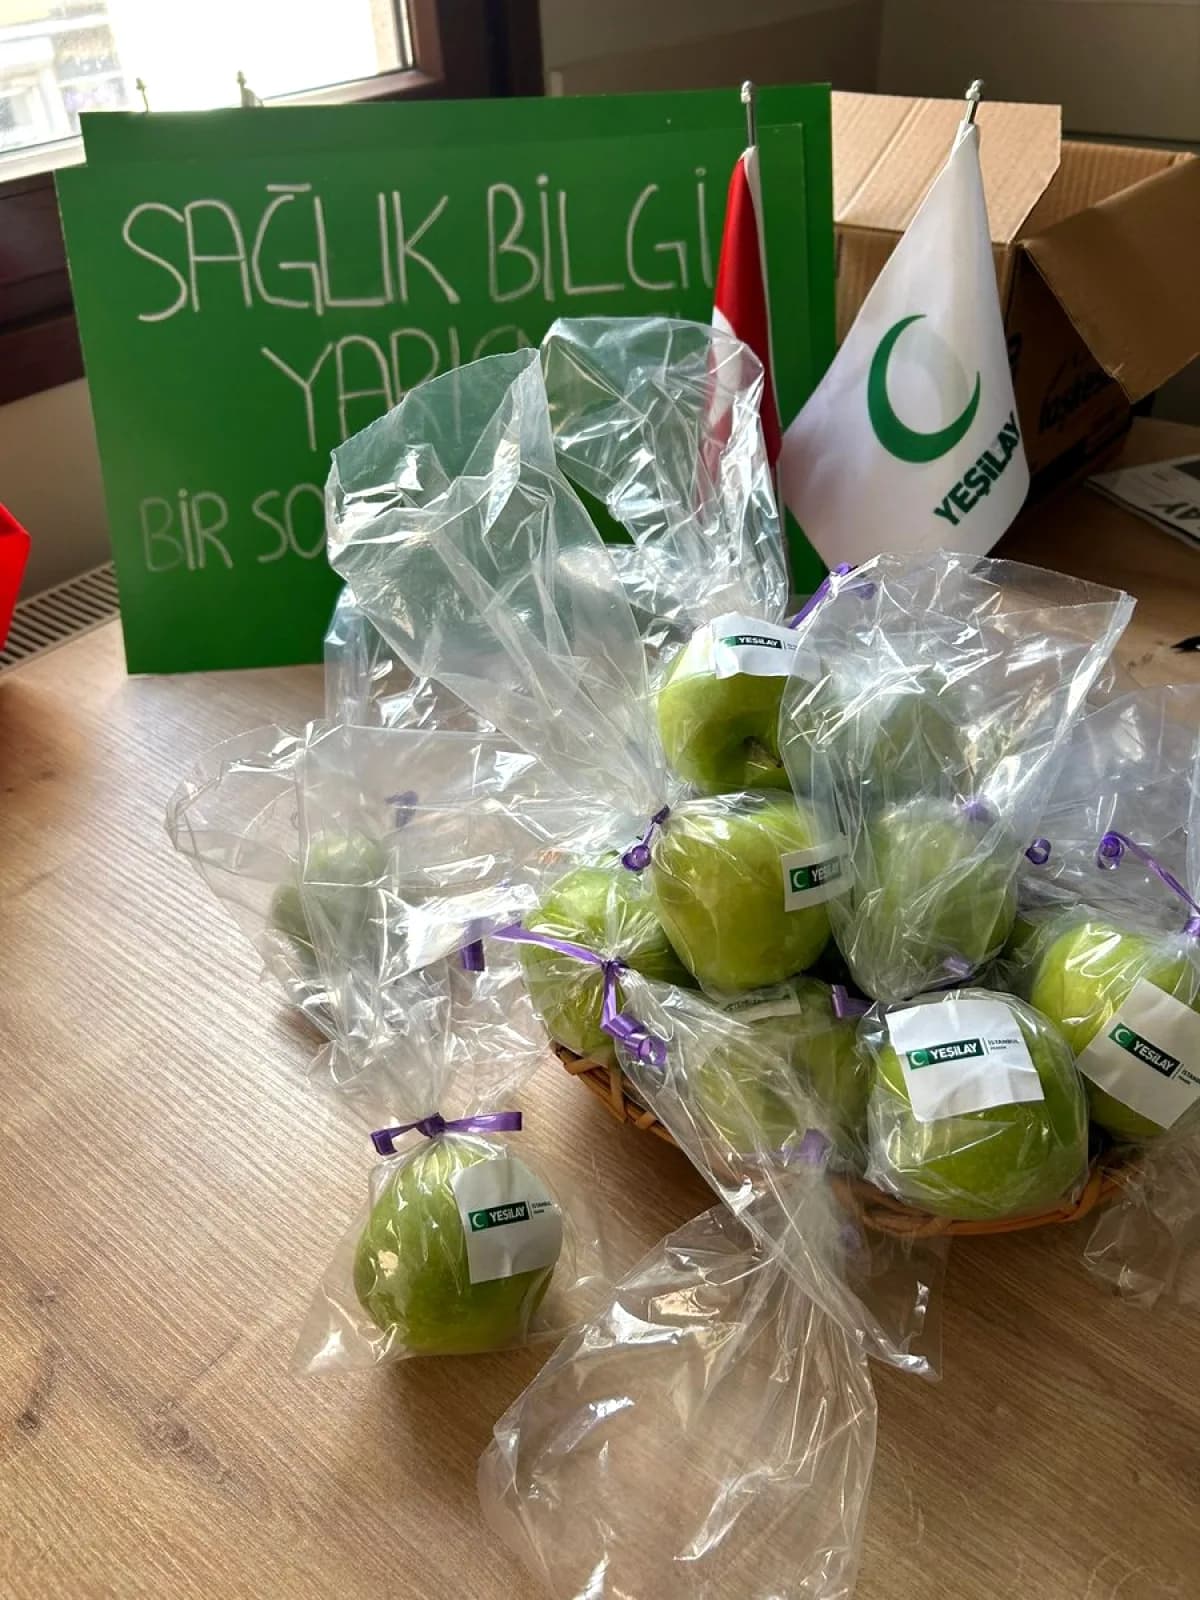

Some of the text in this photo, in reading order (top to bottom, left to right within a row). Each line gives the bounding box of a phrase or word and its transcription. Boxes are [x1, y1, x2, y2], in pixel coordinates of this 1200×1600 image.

[121, 167, 713, 322] SAĞLIK BİLGİ
[933, 409, 1020, 526] YEŞİLAY
[140, 487, 234, 572] BİR
